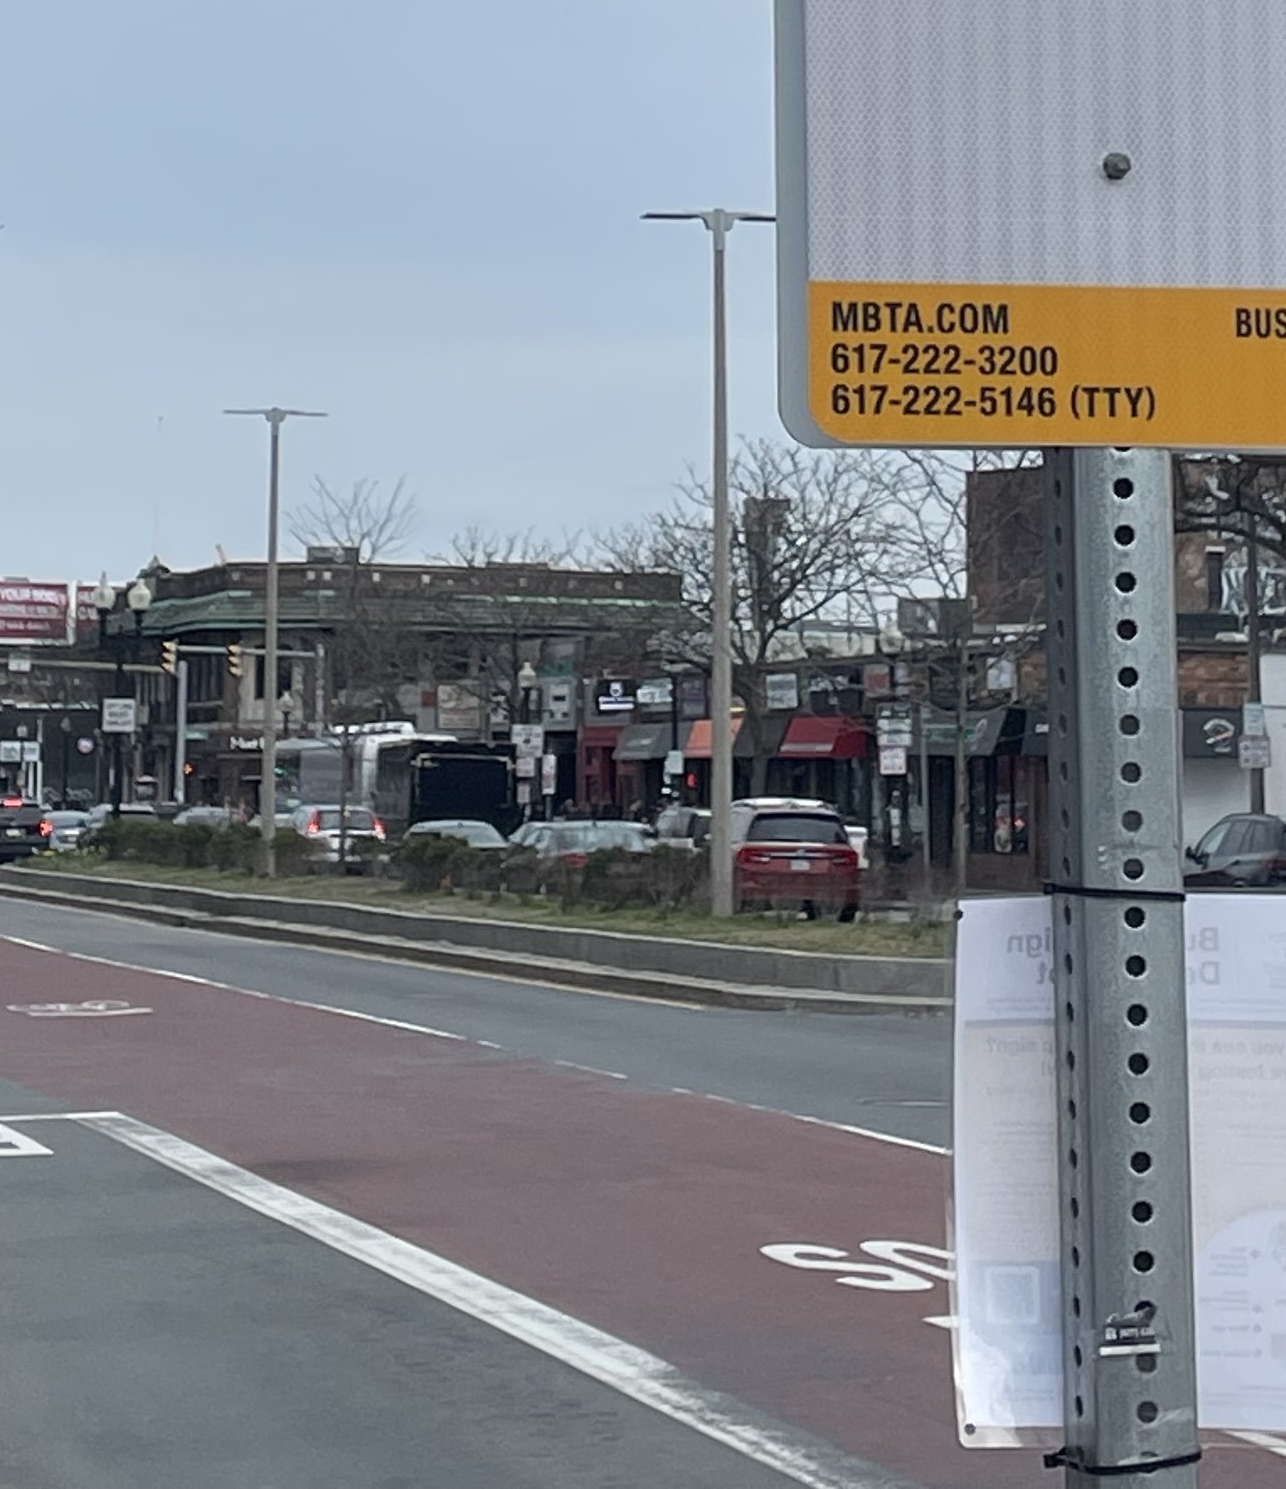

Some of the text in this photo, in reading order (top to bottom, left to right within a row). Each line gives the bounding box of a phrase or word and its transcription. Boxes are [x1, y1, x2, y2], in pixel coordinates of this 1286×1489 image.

[831, 301, 1010, 335] MBTA.COM
[830, 343, 1059, 377] 617-222-3200
[830, 384, 1157, 421] 617-222-5146 (TTY)
